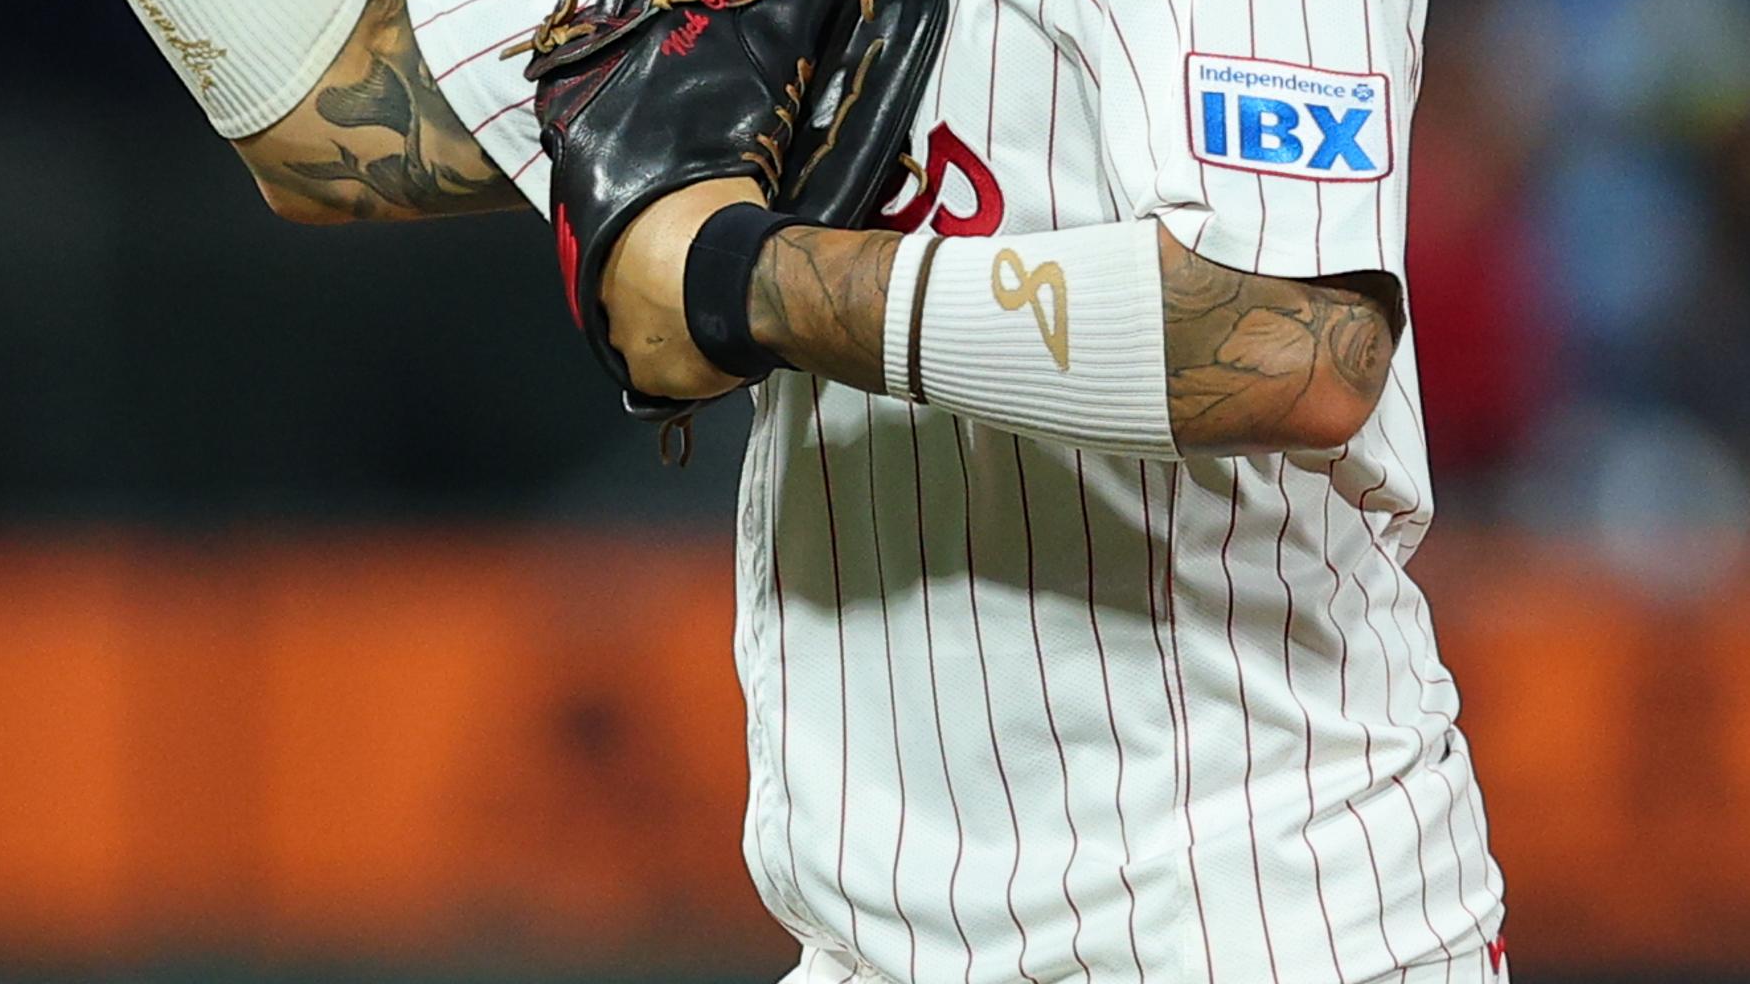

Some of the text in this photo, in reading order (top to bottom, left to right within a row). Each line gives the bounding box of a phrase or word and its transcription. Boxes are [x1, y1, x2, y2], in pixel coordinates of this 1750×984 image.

[661, 9, 712, 56] Nick
[1200, 64, 1346, 98] Independence
[1201, 91, 1377, 171] IBX
